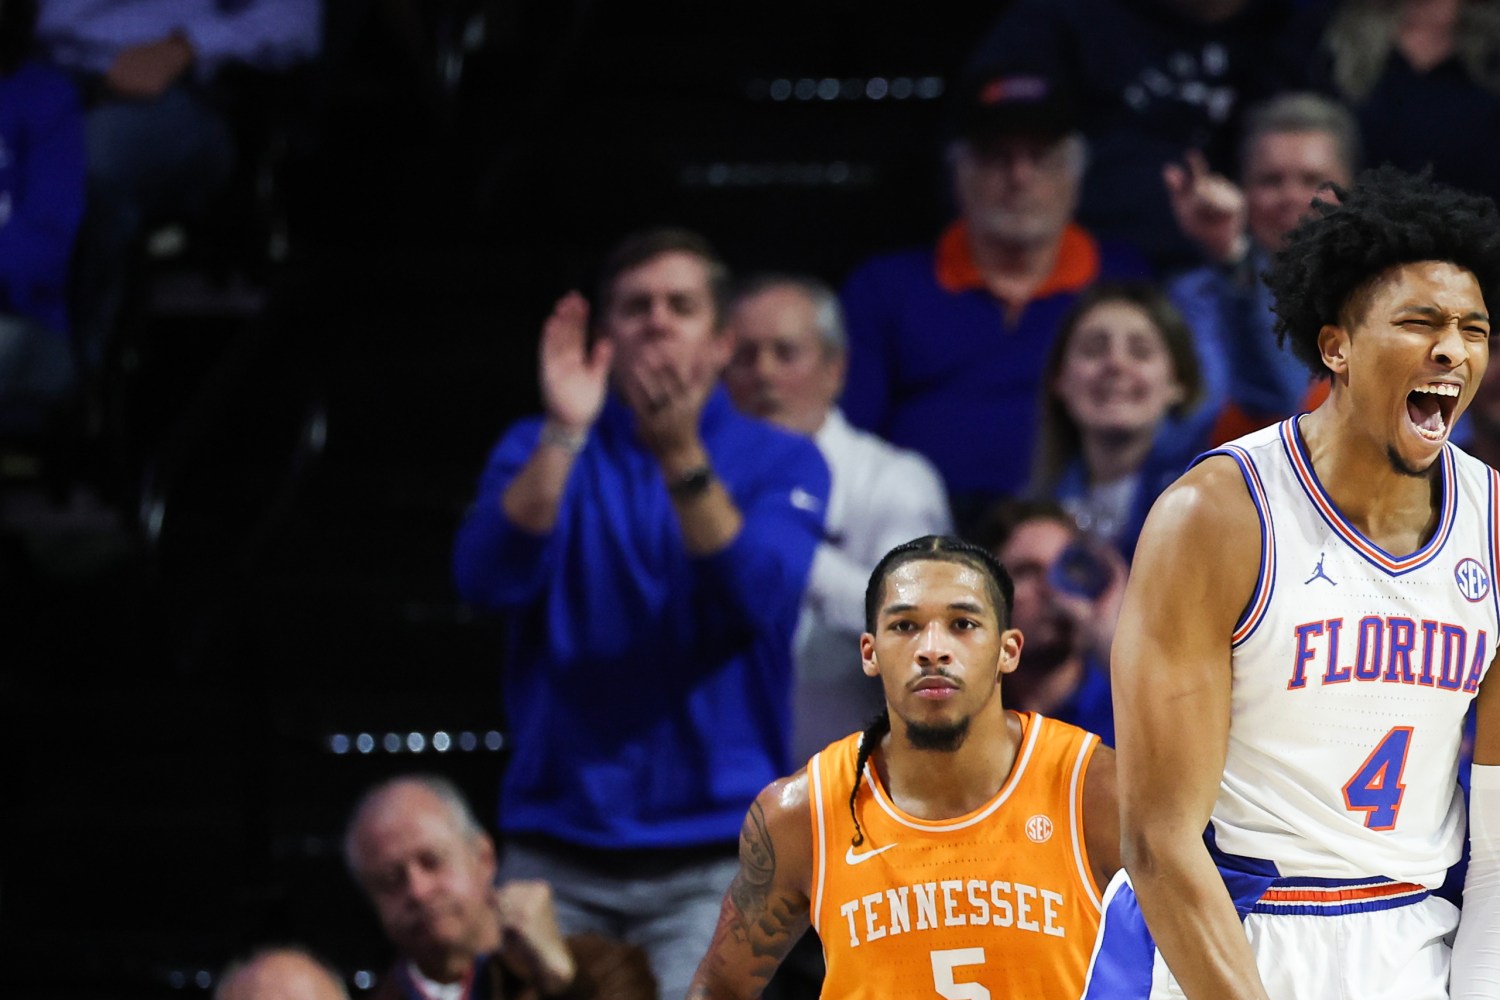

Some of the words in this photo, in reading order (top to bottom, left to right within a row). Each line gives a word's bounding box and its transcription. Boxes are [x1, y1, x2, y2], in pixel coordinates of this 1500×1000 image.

[1456, 559, 1489, 601] SEC
[1287, 615, 1487, 694] FLORIDA
[1341, 726, 1414, 831] 4
[1026, 816, 1052, 841] SEC
[840, 880, 1065, 947] TENNESSEE
